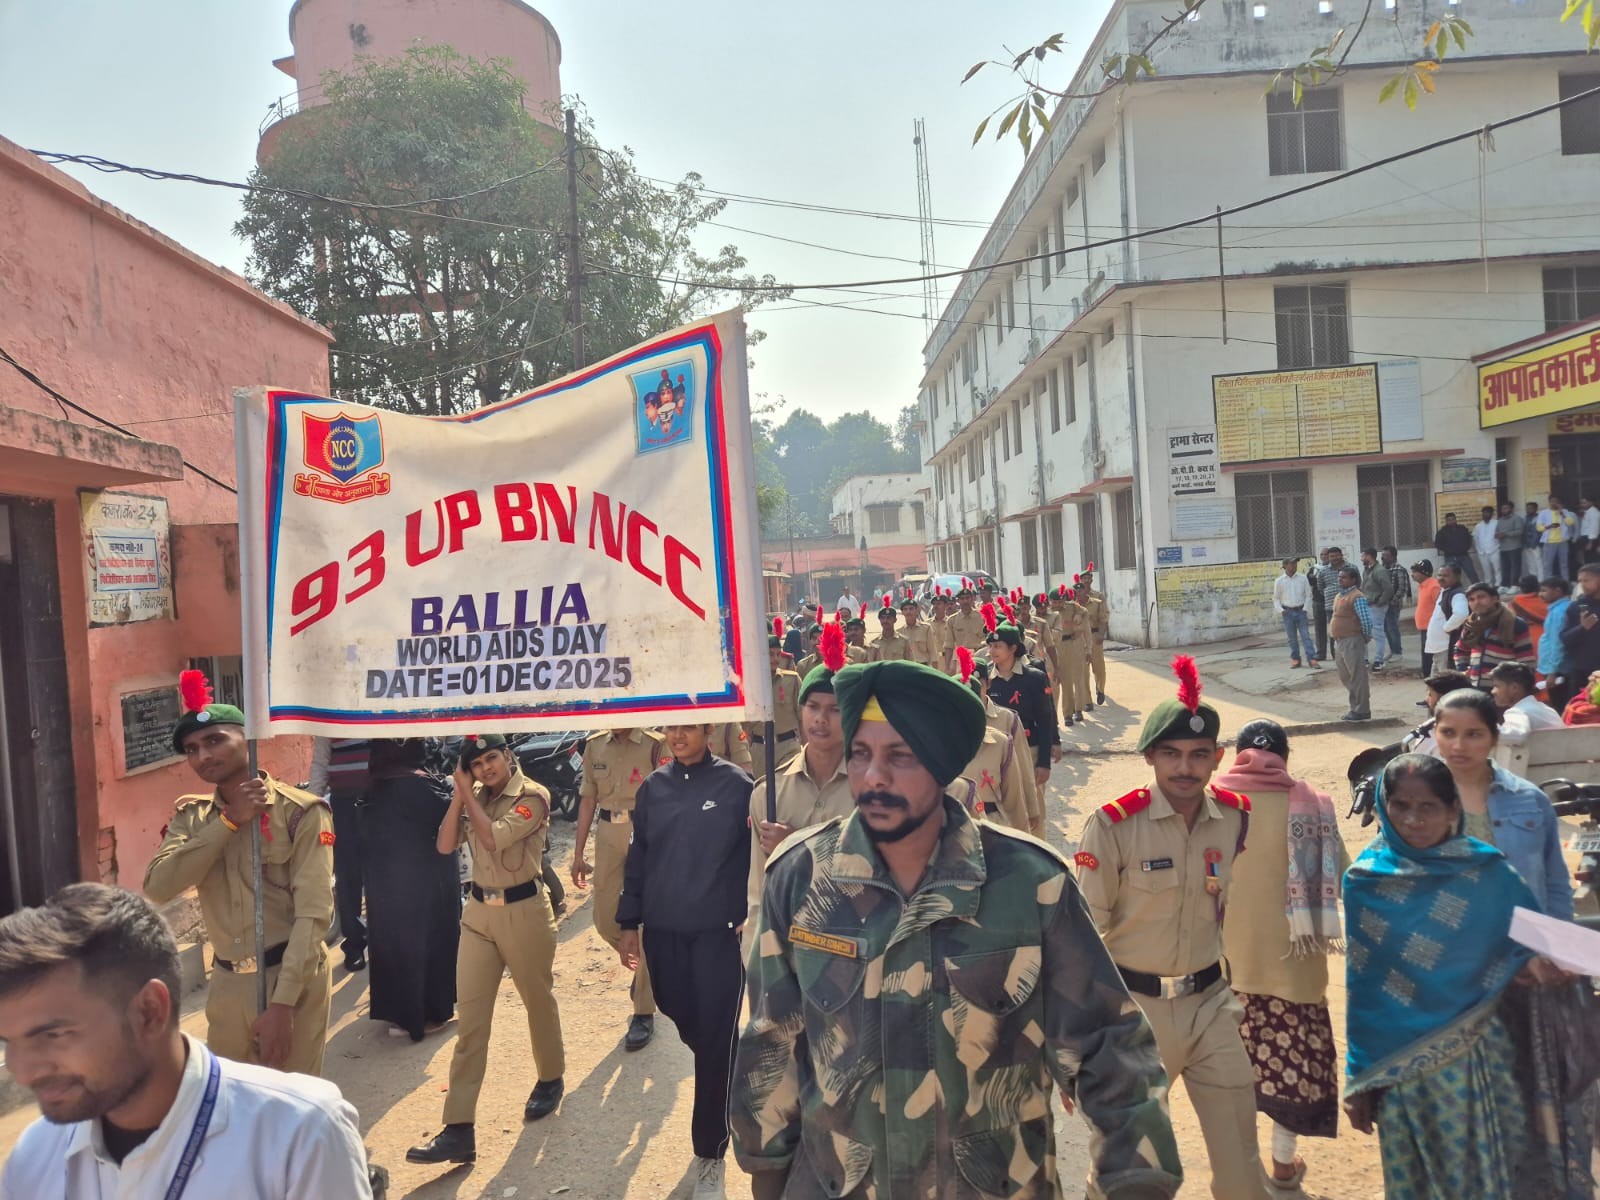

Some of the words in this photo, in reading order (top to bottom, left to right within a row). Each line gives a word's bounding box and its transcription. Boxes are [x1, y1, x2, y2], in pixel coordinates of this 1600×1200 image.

[331, 439, 355, 458] NCC
[1169, 435, 1190, 449] ट्रामा
[1191, 432, 1214, 445] सेन्टर
[290, 528, 387, 637] 93
[405, 489, 482, 567] UP
[494, 482, 577, 545] BN
[588, 491, 705, 622] NCC
[411, 582, 590, 637] BALLIA
[397, 634, 482, 666] WORLD
[485, 626, 545, 661] AIDS
[552, 624, 607, 656] DAY
[555, 656, 632, 690] 2025
[1078, 855, 1094, 866] NCC
